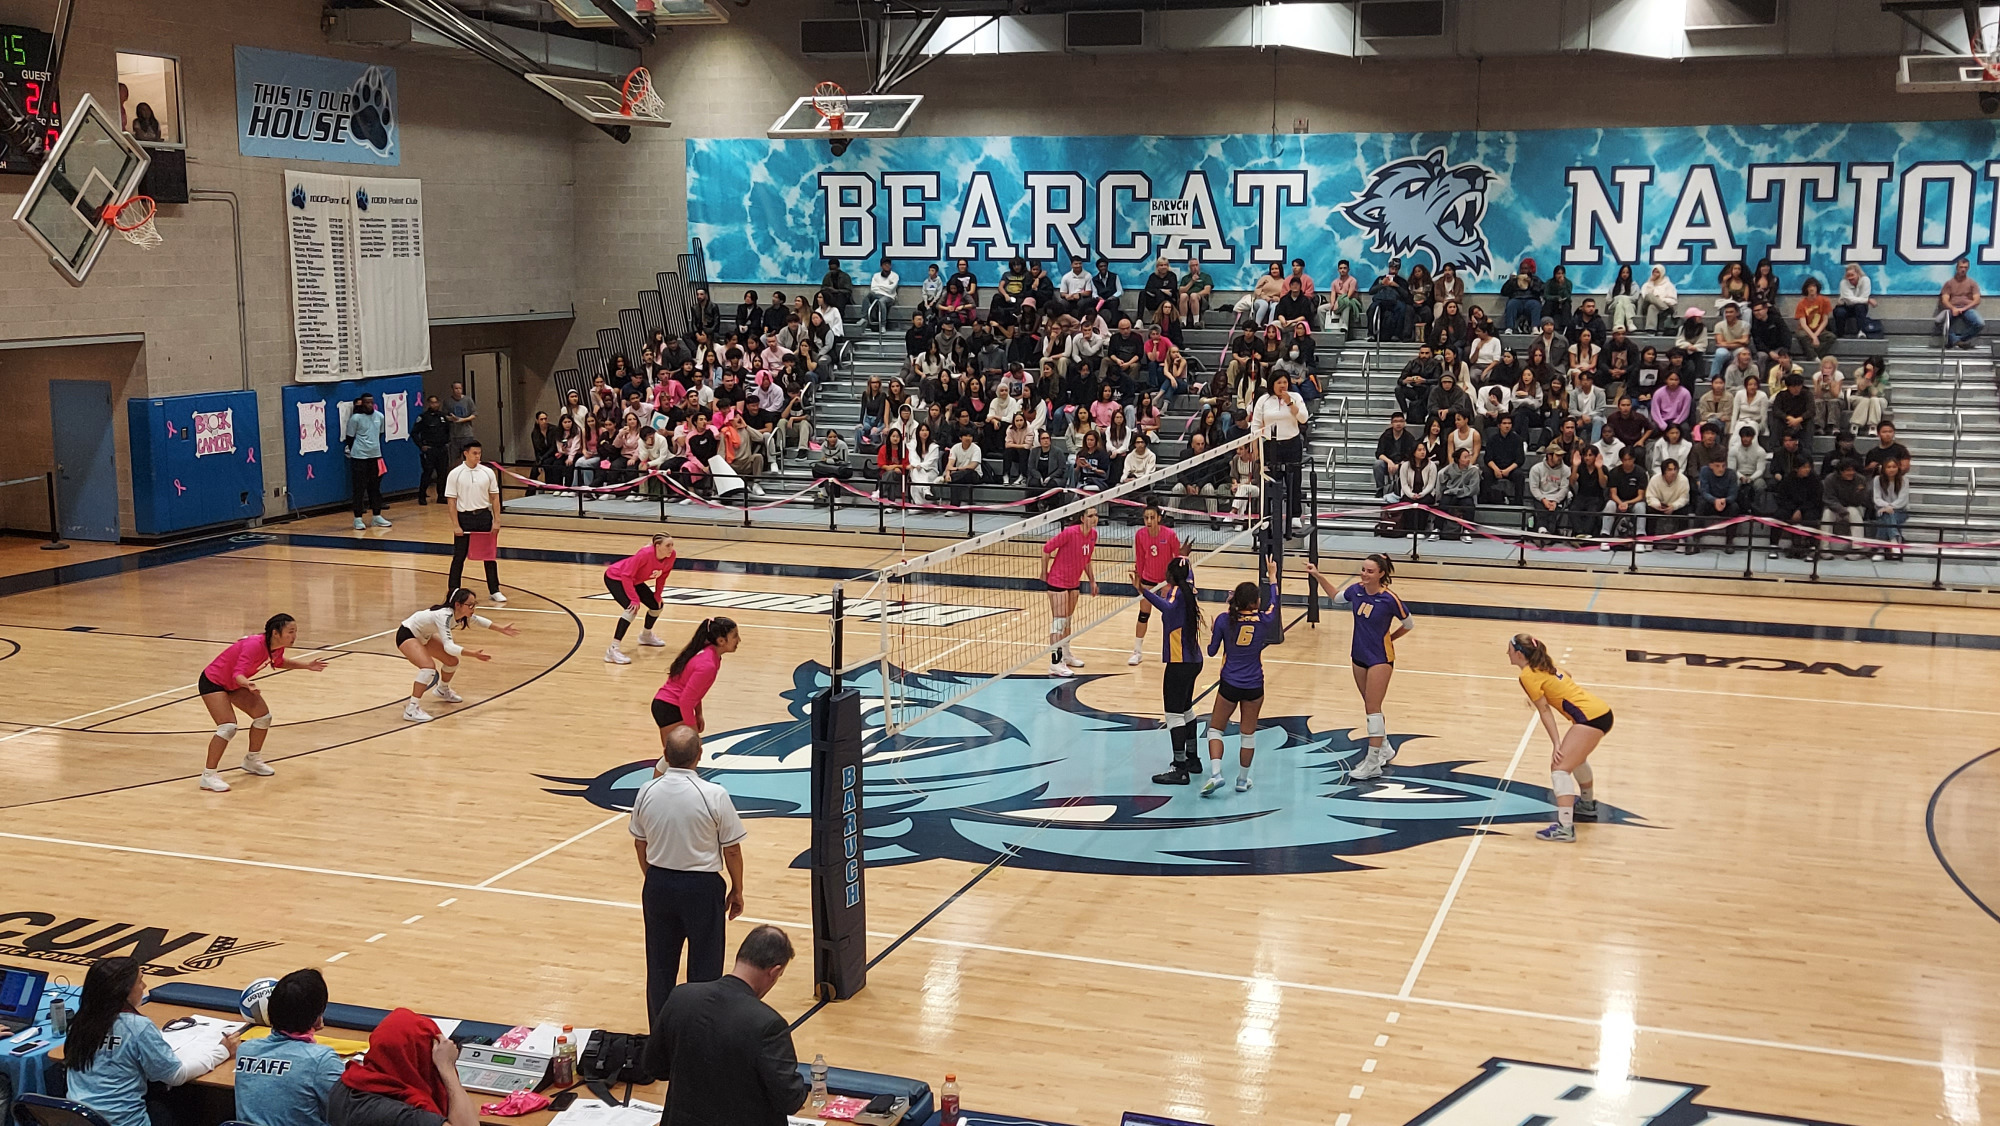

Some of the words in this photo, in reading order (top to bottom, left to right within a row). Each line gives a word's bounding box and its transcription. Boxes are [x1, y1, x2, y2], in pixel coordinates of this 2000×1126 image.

[21, 69, 52, 81] GUEST
[253, 82, 292, 106] THIS
[296, 87, 314, 108] IS
[317, 90, 352, 112] OUR
[247, 105, 352, 143] HOUSE
[388, 196, 404, 205] Point
[405, 197, 418, 205] Club
[1152, 200, 1189, 211] BARUCH
[817, 170, 1308, 264] BEARCAT
[1151, 212, 1188, 227] FAMILY
[198, 433, 234, 454] CANCER
[1081, 543, 1090, 556] 11
[1150, 544, 1158, 557] 3
[1235, 625, 1255, 646] 6
[1625, 649, 1884, 678] NCAA
[842, 764, 860, 909] BARUCH
[236, 1056, 291, 1077] STAFF
